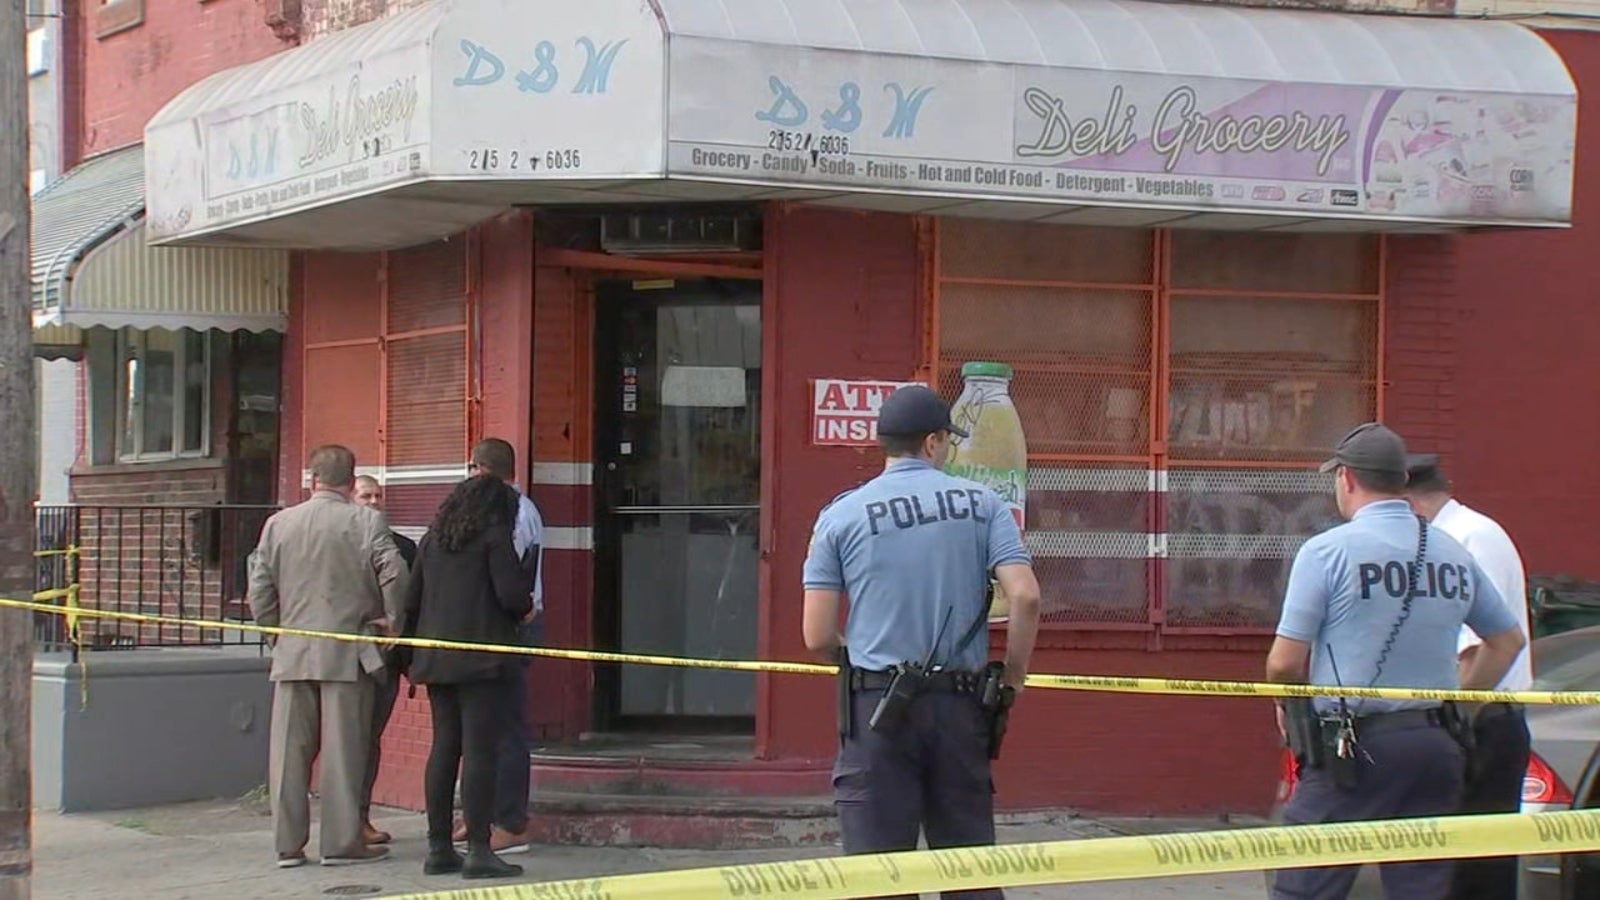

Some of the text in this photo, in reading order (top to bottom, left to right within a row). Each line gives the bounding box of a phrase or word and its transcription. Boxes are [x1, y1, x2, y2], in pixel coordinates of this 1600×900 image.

[453, 39, 505, 87] D
[755, 75, 808, 127] D
[1016, 84, 1138, 157] Deli
[1150, 84, 1350, 176] Grocery
[545, 149, 582, 170] 6036
[692, 147, 750, 170] Grocery
[762, 152, 808, 174] Candy
[819, 157, 856, 176] Soda
[866, 160, 908, 180] Fruits
[918, 164, 942, 182] Hot
[944, 166, 972, 183] and
[974, 167, 1006, 185] Cold
[1009, 169, 1042, 189] Food
[1056, 174, 1126, 197] Detergent
[1136, 177, 1214, 199] Vegetables
[818, 419, 878, 440] INSI
[865, 488, 988, 535] POLICE
[1359, 560, 1470, 602] POLICE
